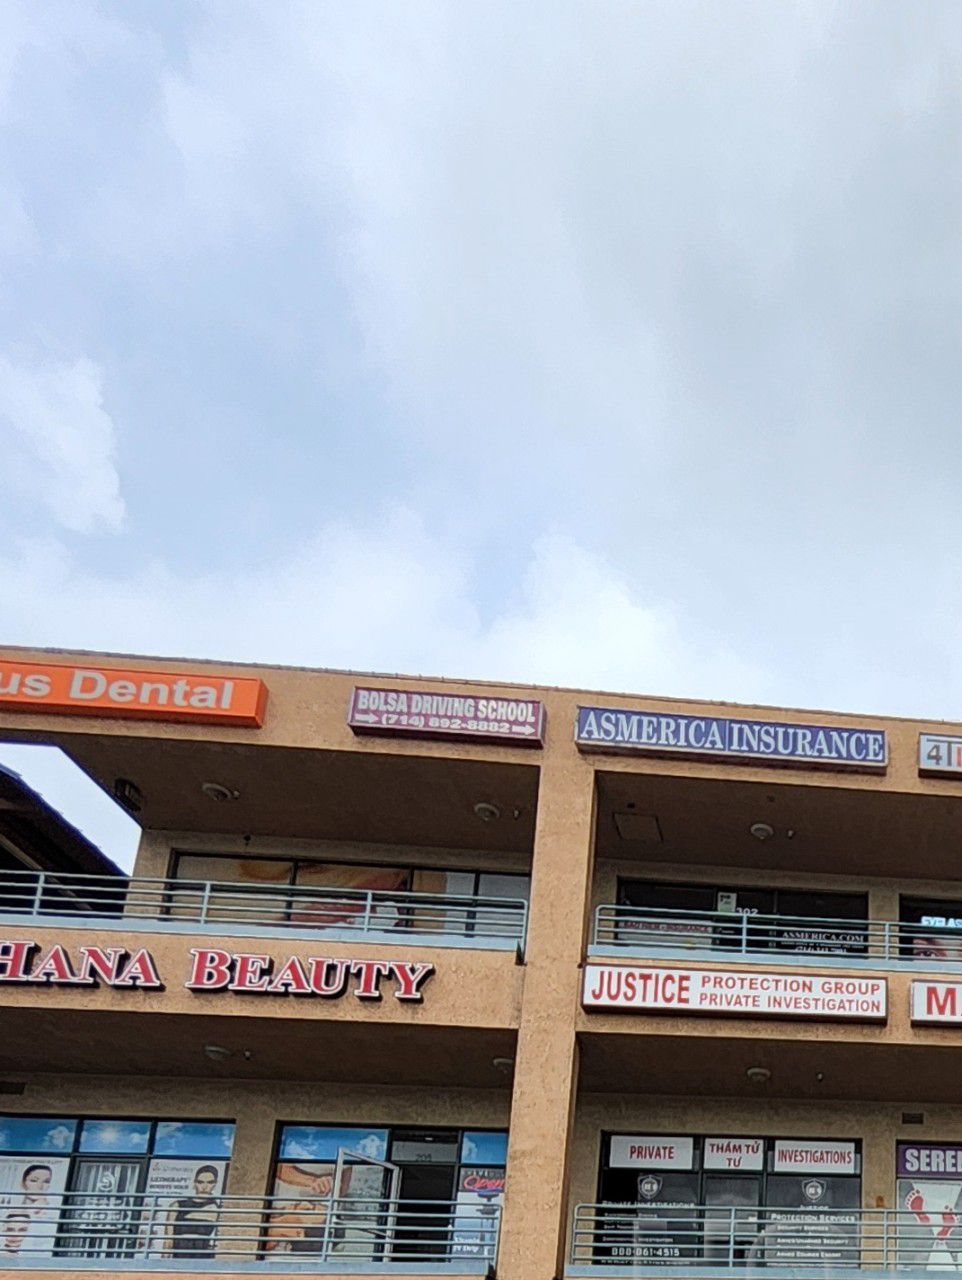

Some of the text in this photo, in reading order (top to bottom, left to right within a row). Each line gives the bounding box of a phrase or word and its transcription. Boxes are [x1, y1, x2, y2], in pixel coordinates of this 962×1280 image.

[69, 669, 234, 710] Dental
[357, 689, 536, 723] BOLSA DRIVING SCHOOL
[381, 713, 425, 728] (714)
[580, 708, 885, 762] ASMERICA INSURANCE
[0, 940, 435, 1001] HANA BEAUTY
[591, 970, 881, 1005] JUSTICE PROTECTION GROUP
[699, 992, 881, 1013] PRIVATE INVESTIGATION
[629, 1145, 675, 1160] PRIVATE
[777, 1149, 853, 1164] INVESTIGATIONS
